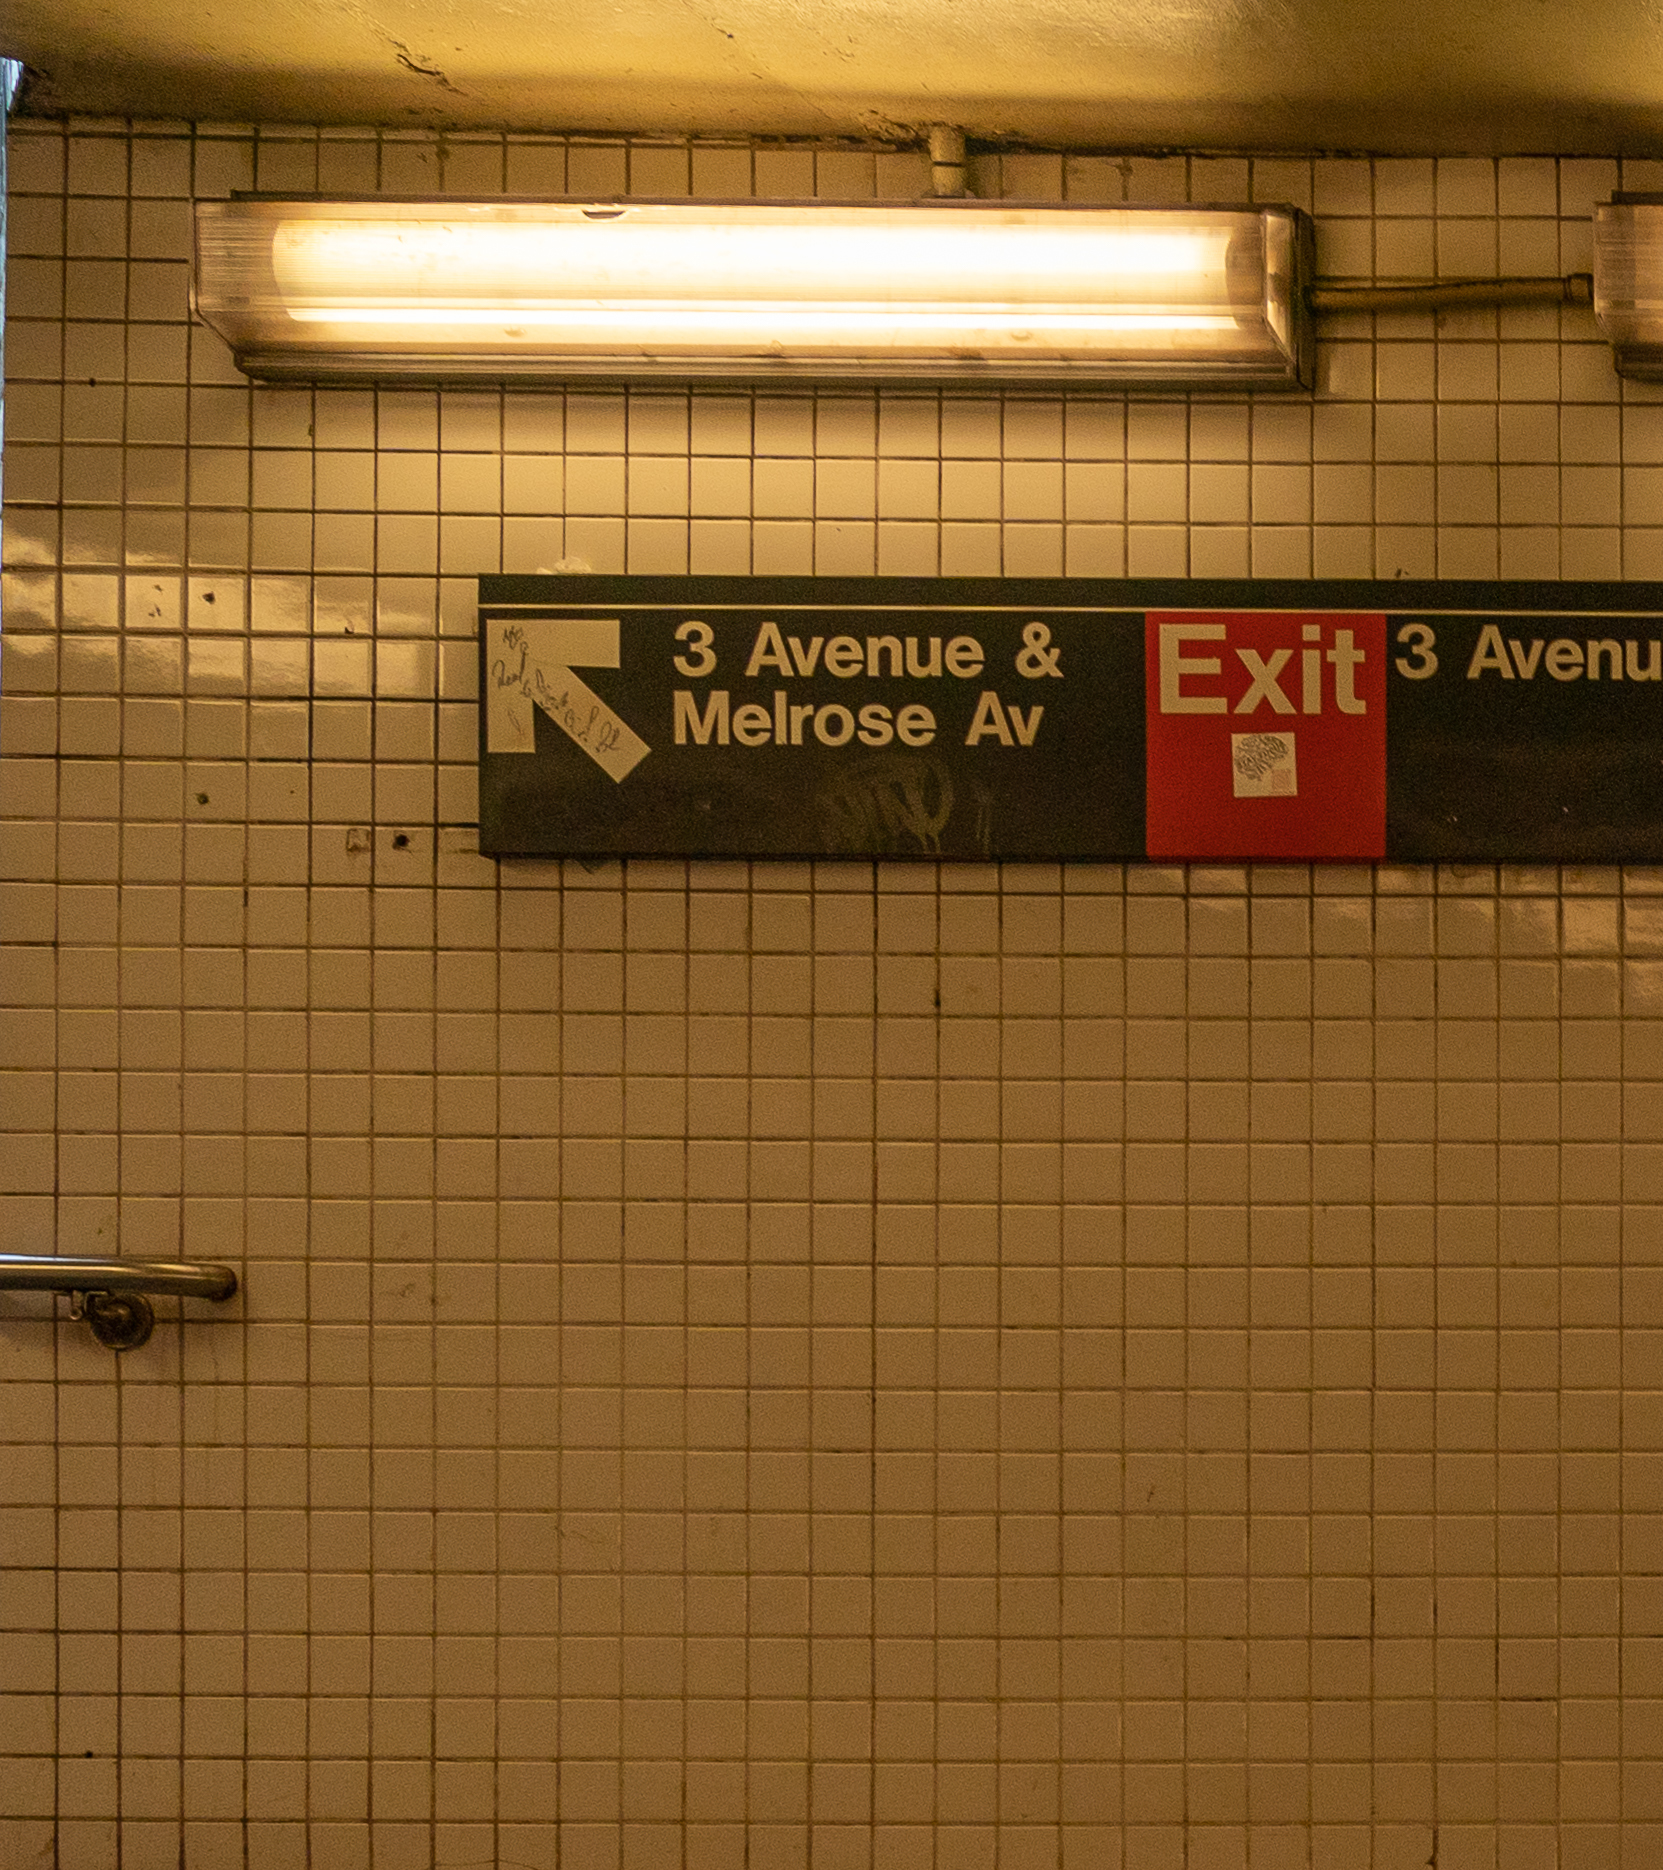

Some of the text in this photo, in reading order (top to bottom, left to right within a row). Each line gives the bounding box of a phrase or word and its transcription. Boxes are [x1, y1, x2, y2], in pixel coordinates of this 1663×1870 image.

[673, 620, 1064, 679] 3 Avenue &
[1158, 622, 1367, 716] Exit
[1395, 624, 1439, 680] 3
[673, 690, 937, 747] Melrose
[965, 690, 1044, 746] Av
